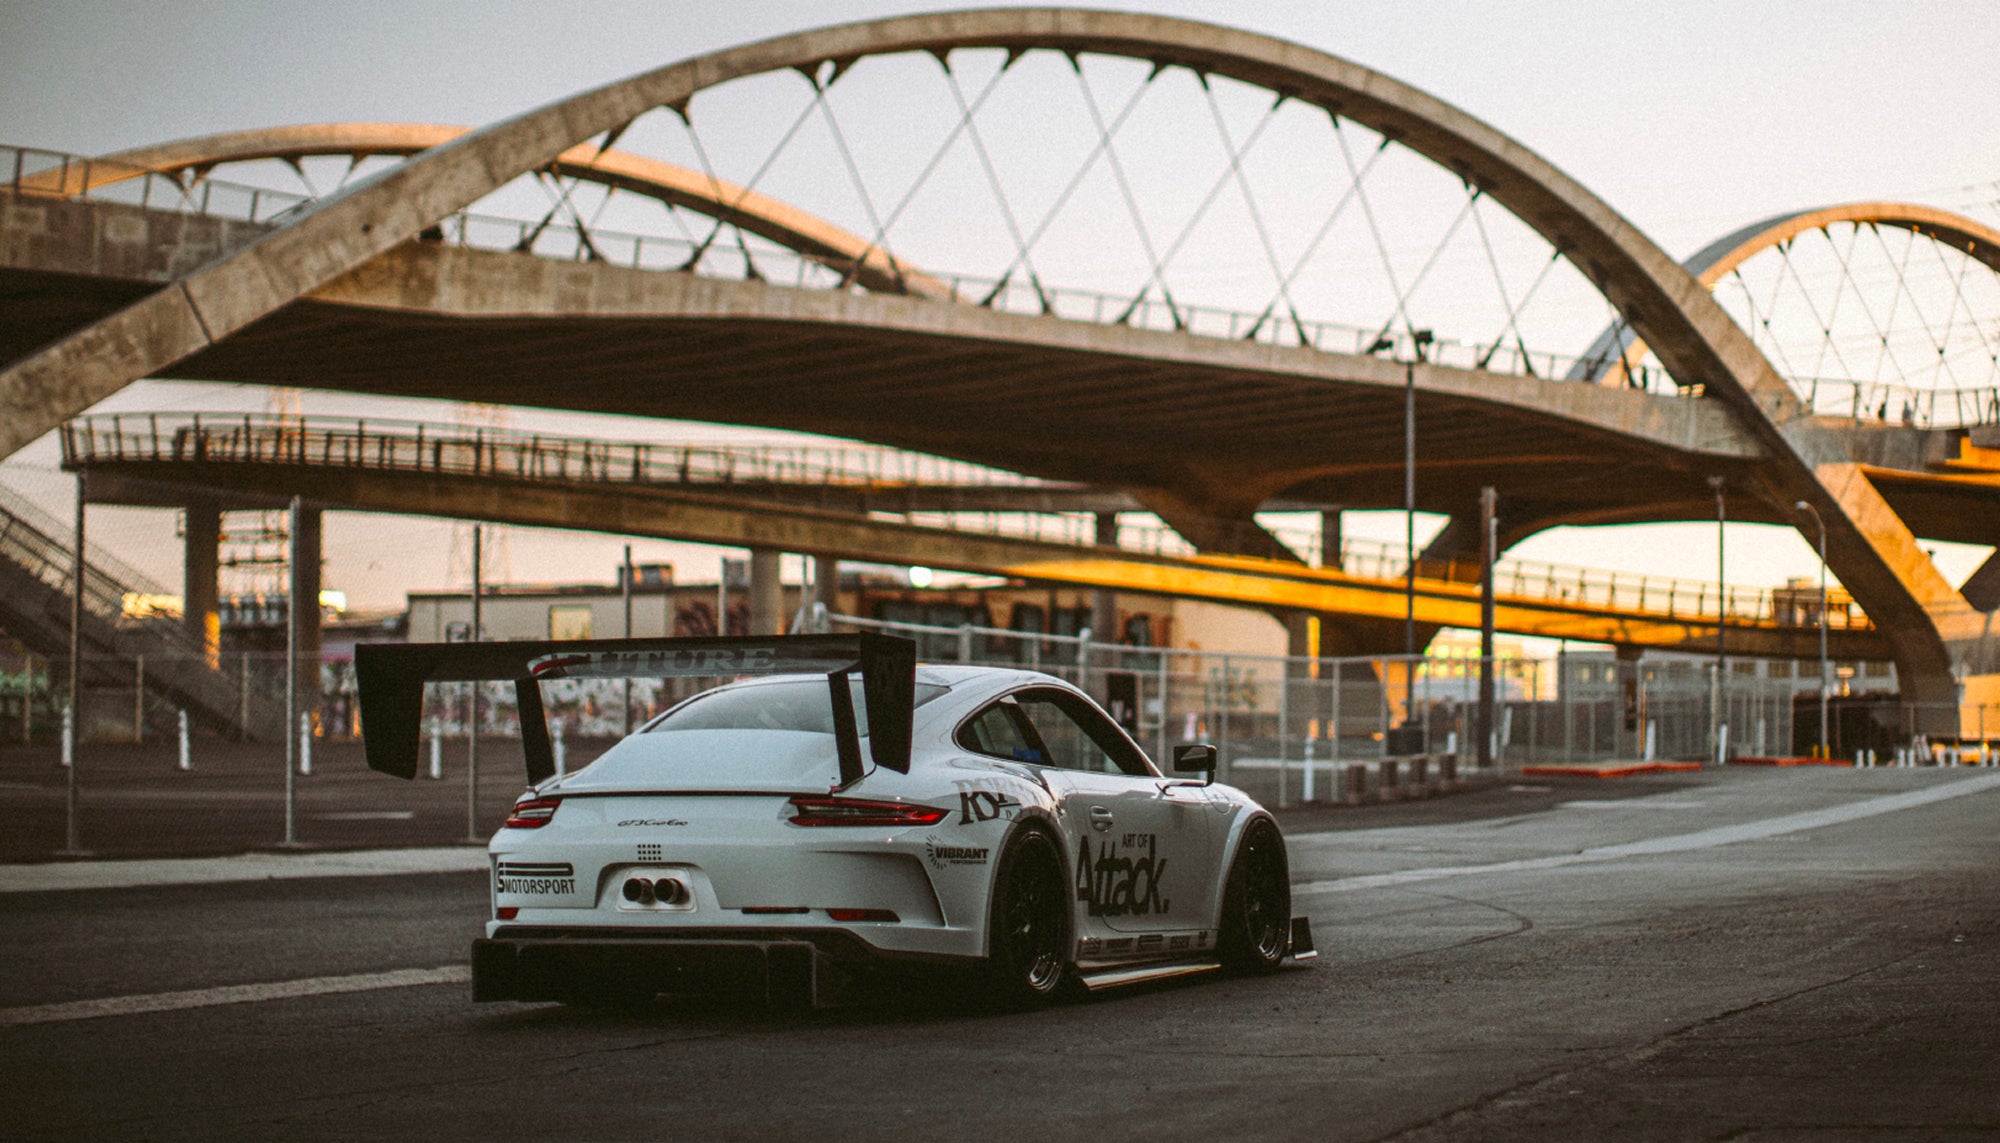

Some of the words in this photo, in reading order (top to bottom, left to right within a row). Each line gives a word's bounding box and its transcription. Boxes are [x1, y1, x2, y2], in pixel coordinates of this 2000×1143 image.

[1122, 833, 1137, 848] ART
[1137, 833, 1149, 848] OF
[935, 847, 989, 859] VIBRANT
[505, 878, 575, 894] MOTORSPORT
